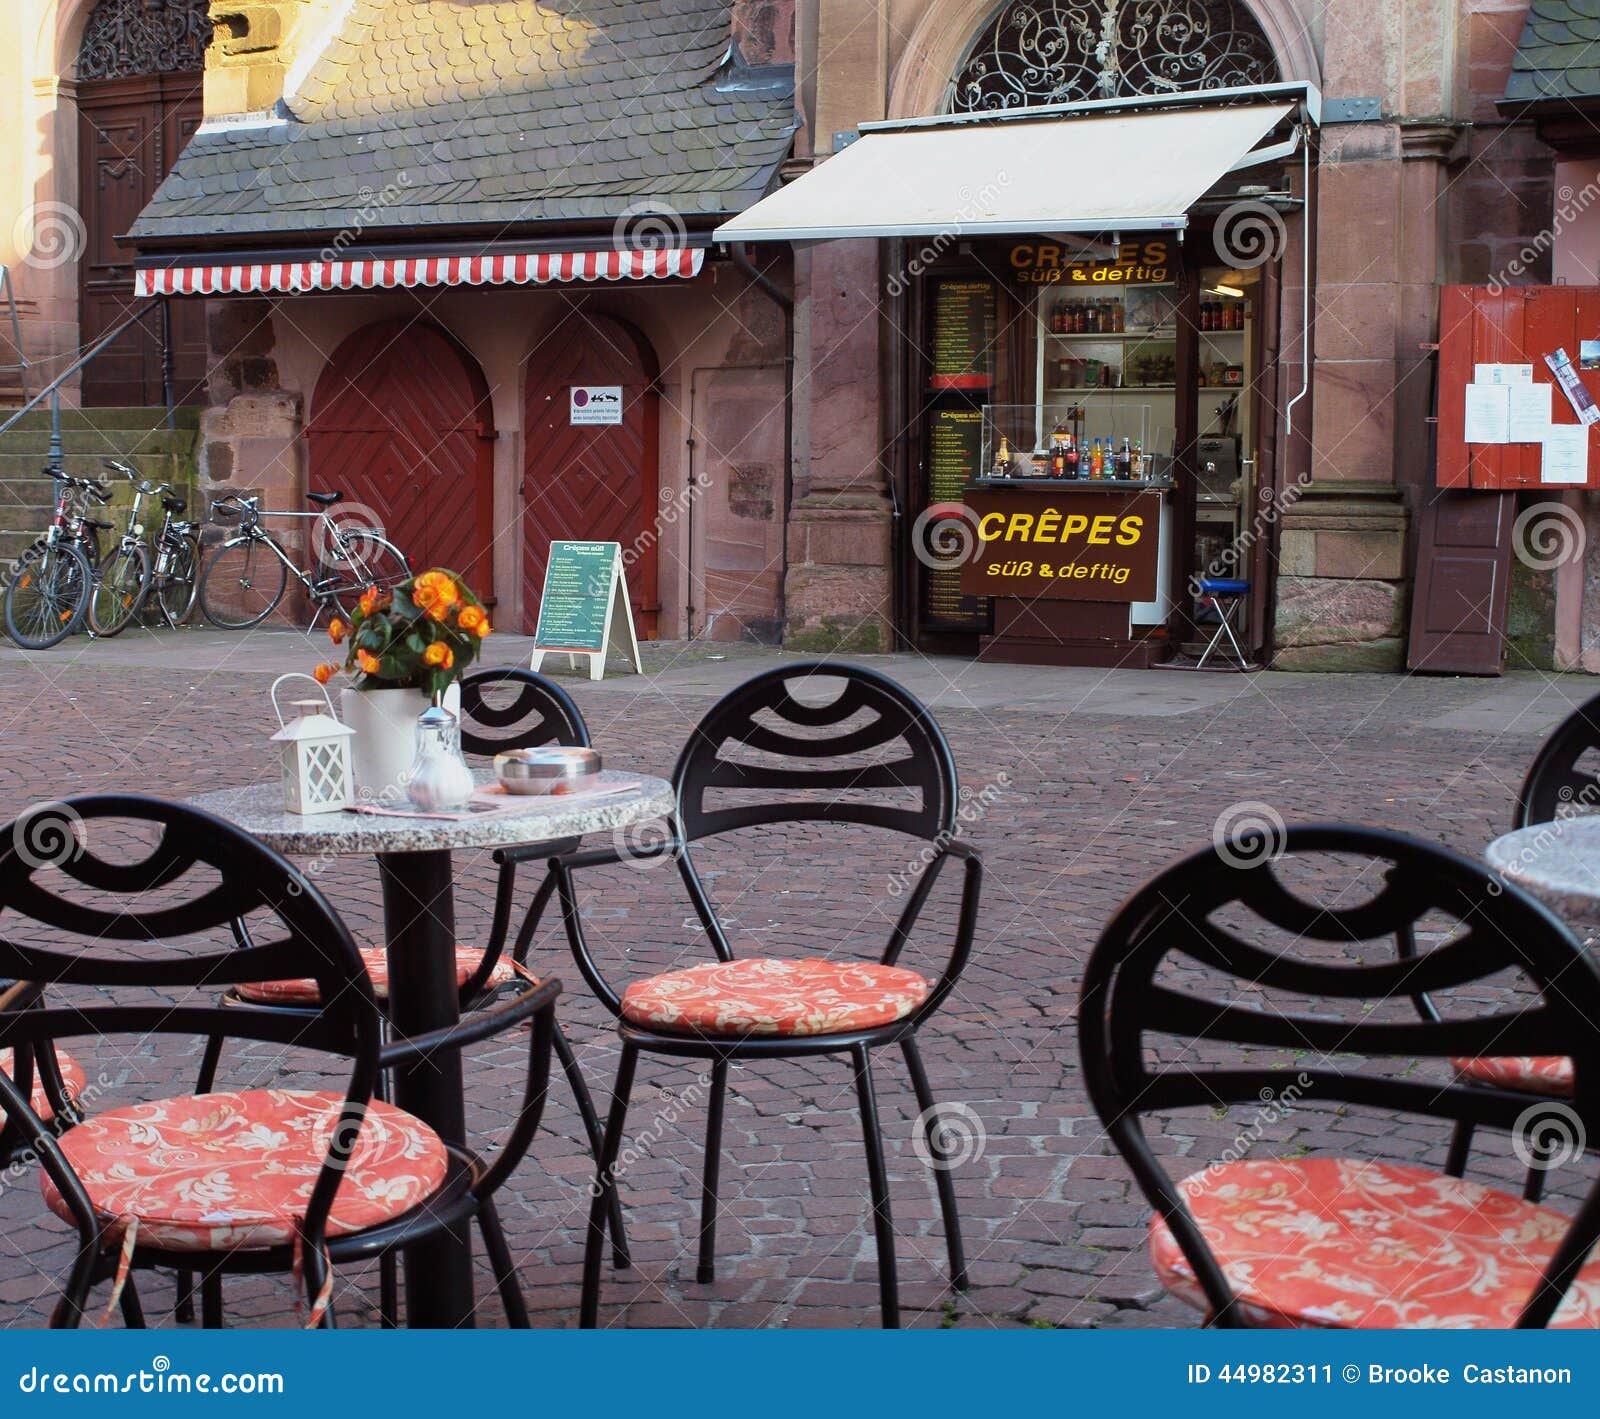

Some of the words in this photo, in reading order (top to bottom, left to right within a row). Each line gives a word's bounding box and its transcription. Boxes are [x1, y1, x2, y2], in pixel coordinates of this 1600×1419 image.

[1010, 242, 1168, 268] CRES
[1017, 268, 1060, 282] süß
[1072, 269, 1087, 281] &
[1092, 266, 1167, 282] deftig
[977, 508, 1144, 546] CRÊPES
[986, 560, 1034, 577] süß
[1038, 563, 1054, 578] &
[1058, 562, 1131, 584] deftig
